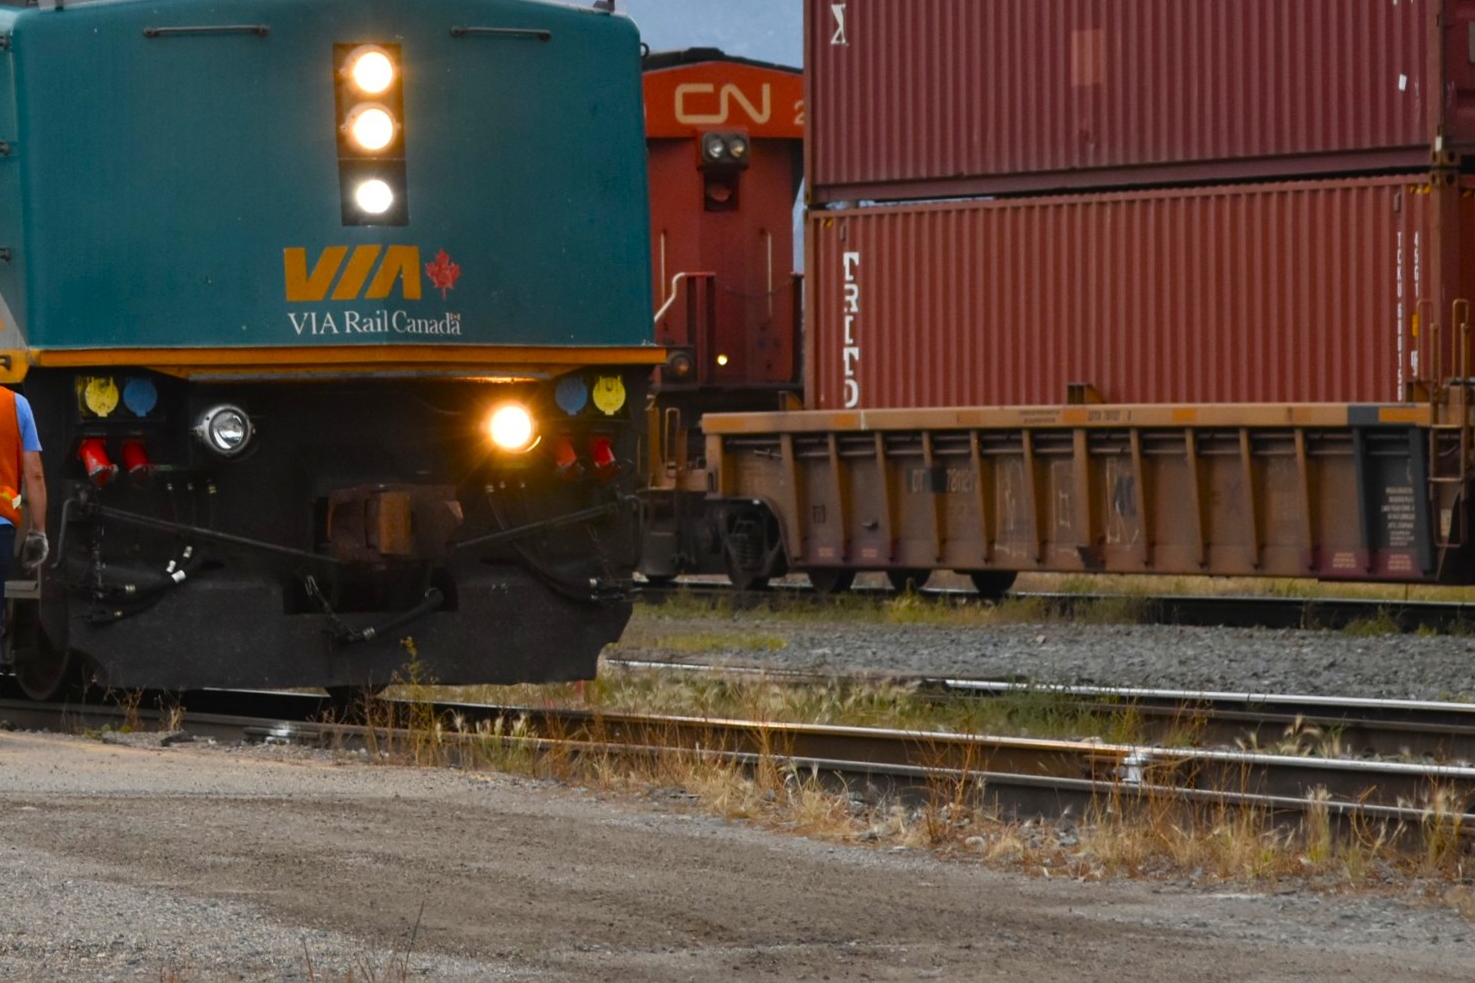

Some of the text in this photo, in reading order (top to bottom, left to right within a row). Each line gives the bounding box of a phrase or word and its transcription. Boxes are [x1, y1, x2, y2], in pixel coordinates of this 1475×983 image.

[674, 83, 771, 124] CN
[283, 244, 422, 302] VIA
[287, 309, 462, 336] VIA Rail Canada
